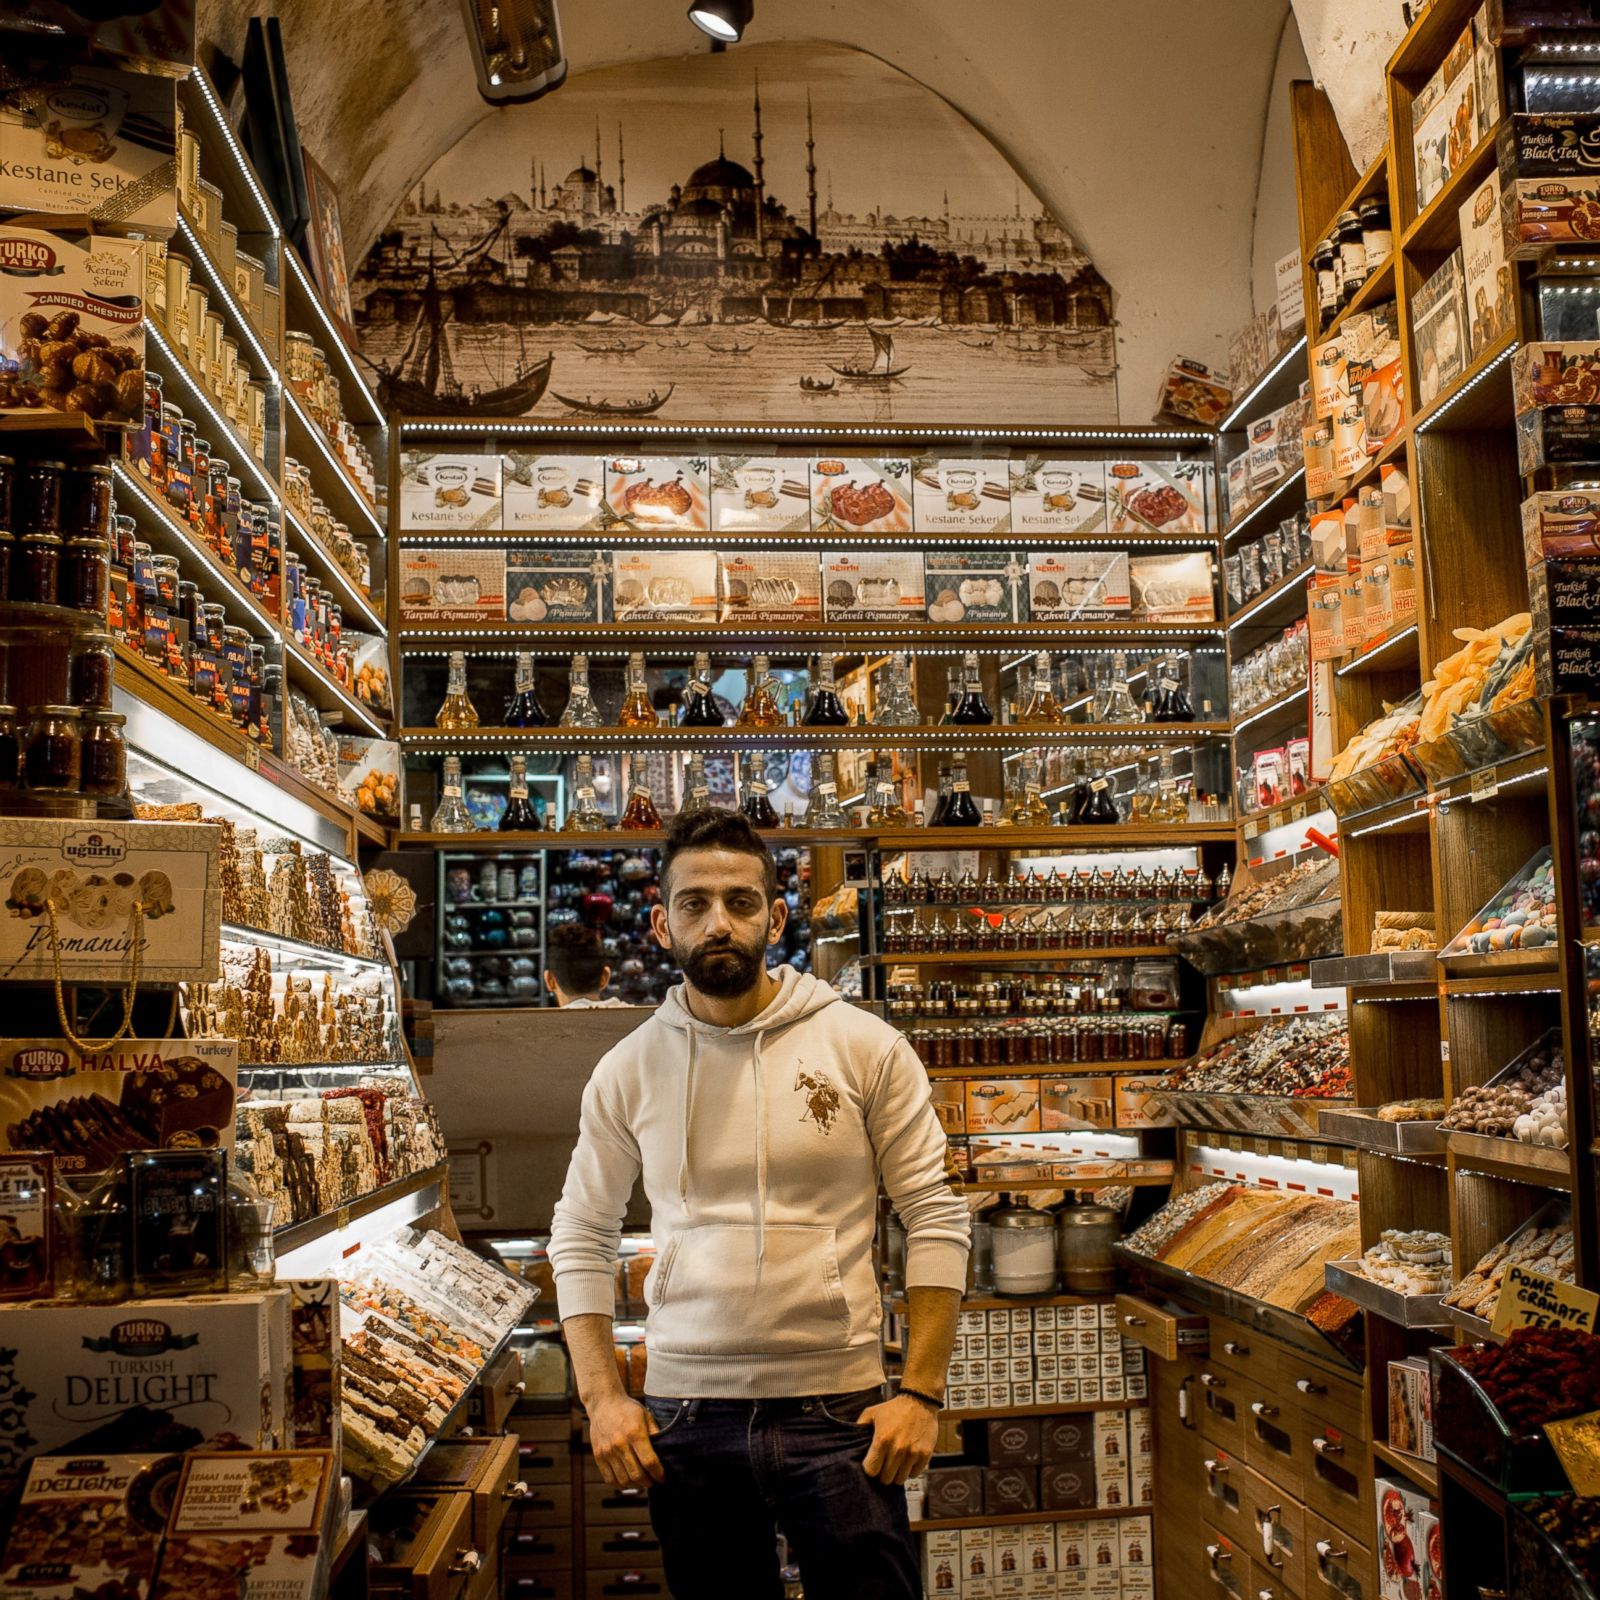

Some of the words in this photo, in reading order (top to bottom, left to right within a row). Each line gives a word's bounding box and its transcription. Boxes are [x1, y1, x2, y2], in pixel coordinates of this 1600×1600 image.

[1521, 133, 1554, 147] Turkish
[1522, 145, 1559, 162] Black
[1557, 146, 1579, 159] Tea
[1540, 184, 1565, 192] TURKO
[87, 262, 129, 277] Kestane
[1468, 249, 1492, 286] Delight
[93, 276, 125, 288] Şekeri
[39, 295, 84, 310] CANDIED
[86, 303, 140, 321] CHESTNUT
[1317, 391, 1340, 408] HALVA
[1252, 447, 1277, 467] Delight
[411, 511, 454, 521] Kestane
[925, 514, 963, 524] Kestane
[1022, 515, 1058, 524] Kestane
[1554, 580, 1588, 594] Turkish
[1555, 592, 1594, 611] Black
[441, 610, 489, 622] Pişmaniye
[618, 609, 655, 621] Kahveli
[656, 610, 702, 622] Pişmaniye
[759, 610, 805, 622] Pişmaniye
[828, 609, 865, 621] Kahveli
[865, 610, 910, 622] Pişmaniye
[1034, 610, 1071, 622] Kahveli
[1556, 647, 1591, 661] Turkish
[1557, 660, 1597, 678] Black
[67, 846, 121, 858] uğurlu
[20, 1050, 64, 1066] TURKO
[195, 1045, 234, 1057] Turkey
[21, 1065, 64, 1073] BABA
[81, 1053, 165, 1073] HALVA
[968, 1117, 994, 1129] HALVA
[56, 1155, 87, 1170] UTS
[1509, 1267, 1558, 1300] POME
[1516, 1288, 1591, 1326] GRANATE
[1519, 1310, 1561, 1329] TEA
[118, 1322, 166, 1336] TURKO
[108, 1359, 174, 1375] TURKISH
[65, 1373, 218, 1407] DELIGHT
[223, 1473, 247, 1481] BABA
